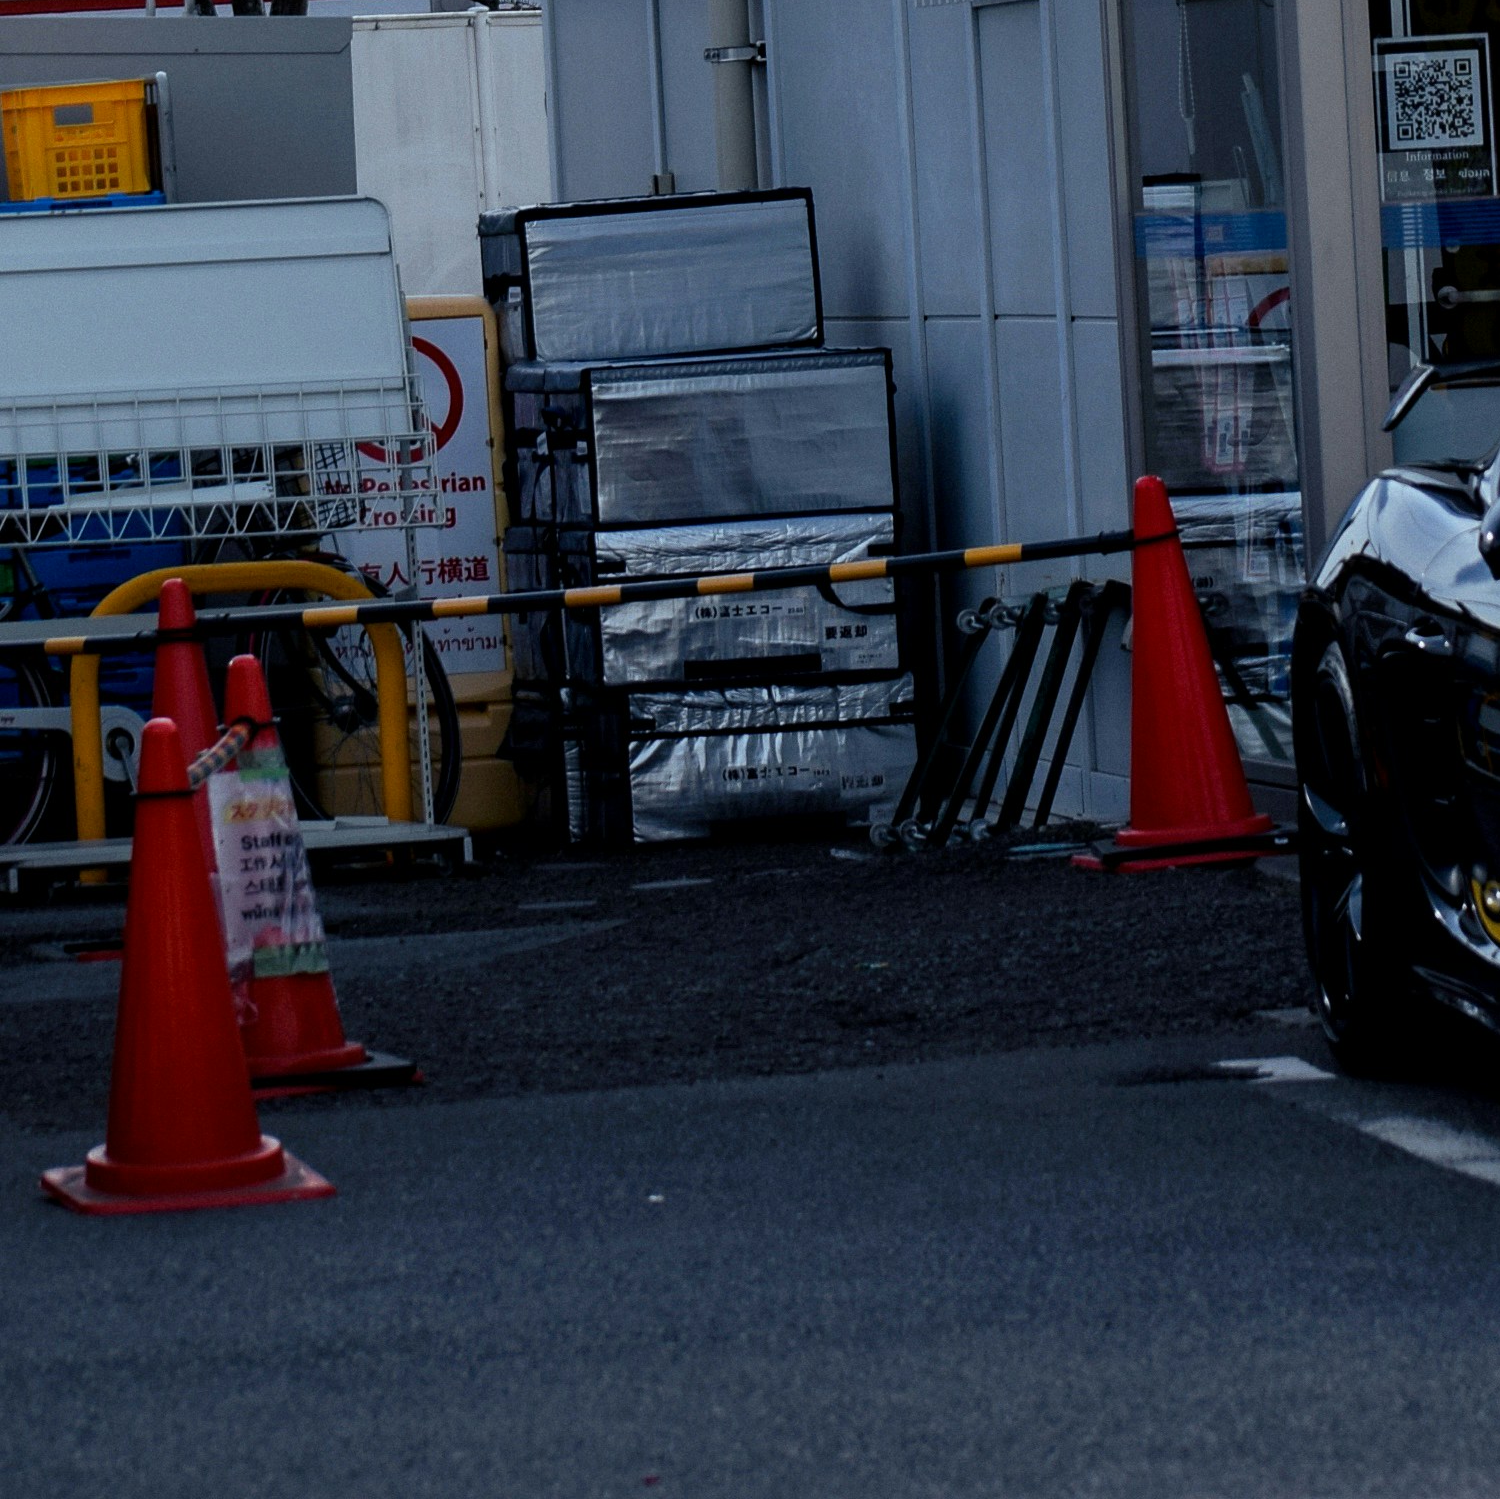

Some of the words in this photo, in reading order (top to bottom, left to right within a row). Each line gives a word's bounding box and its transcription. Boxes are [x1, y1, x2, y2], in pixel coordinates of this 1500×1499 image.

[1405, 149, 1469, 162] Information
[1423, 168, 1446, 182] 정보
[241, 833, 282, 851] Staff
